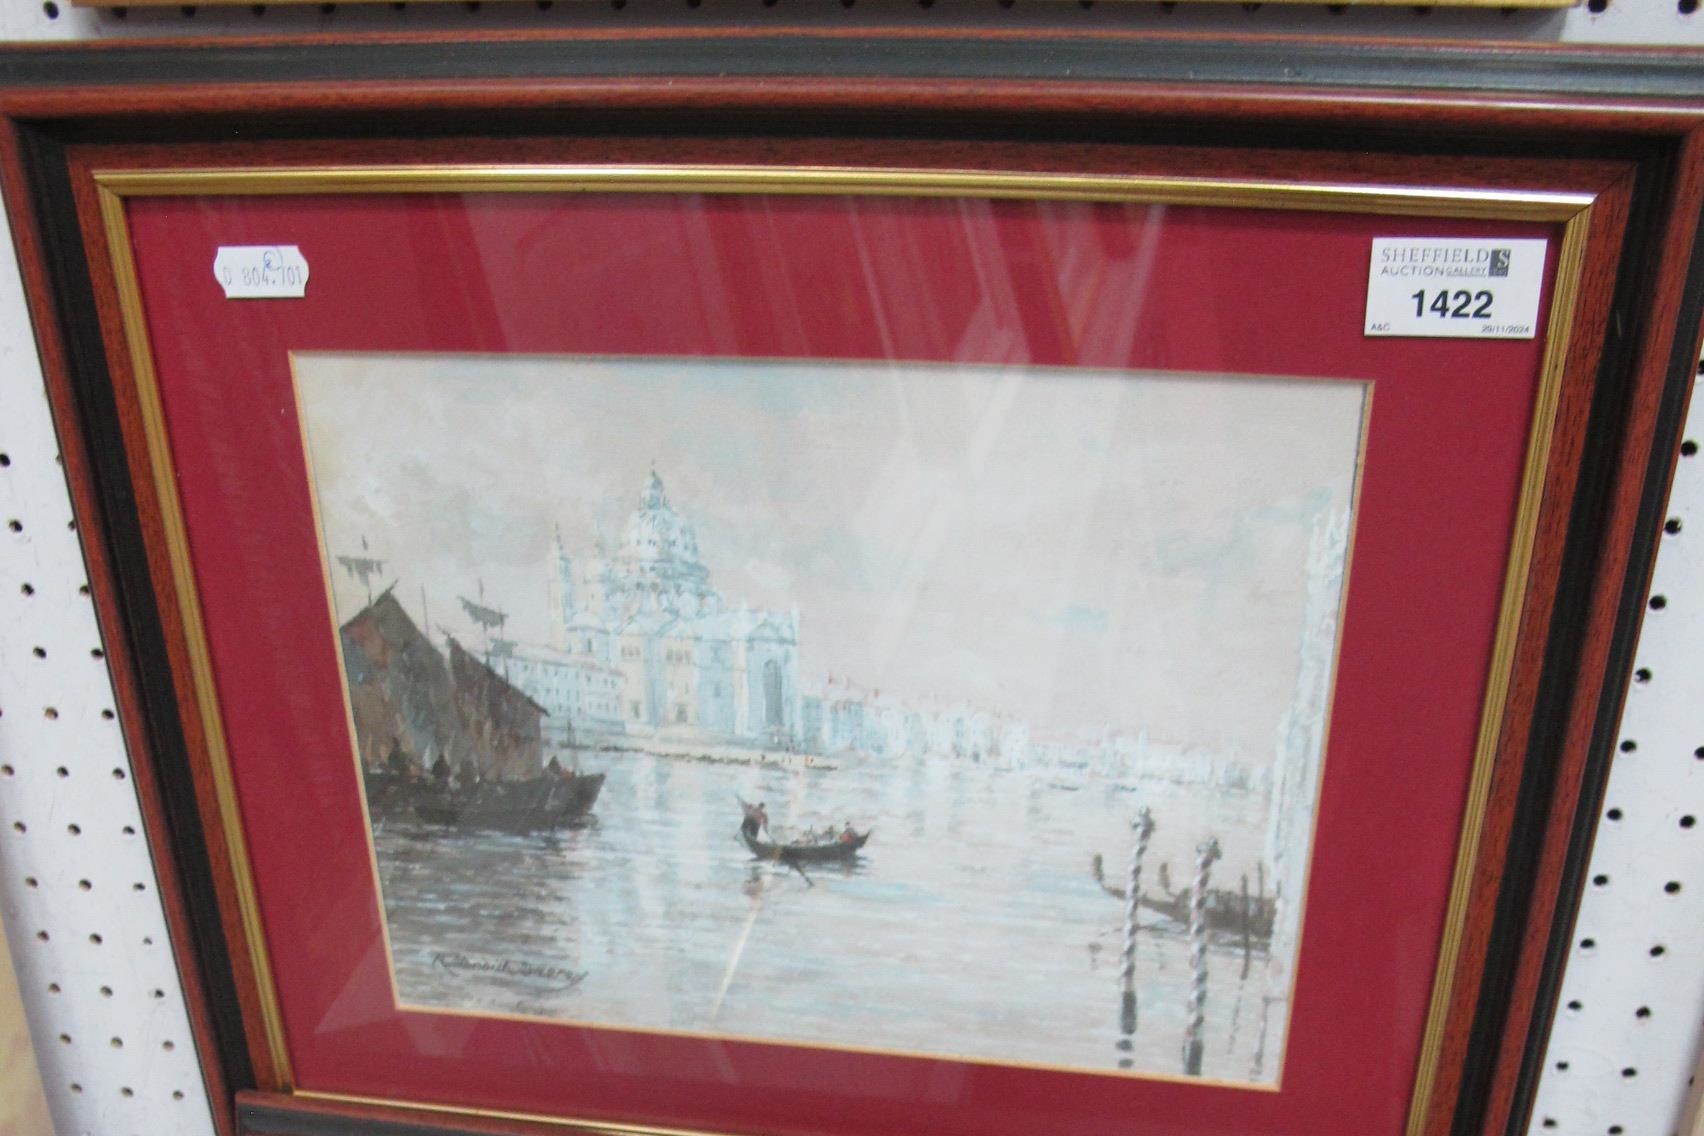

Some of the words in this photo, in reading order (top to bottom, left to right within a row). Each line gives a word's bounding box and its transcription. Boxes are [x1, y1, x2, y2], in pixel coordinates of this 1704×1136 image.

[1381, 247, 1489, 263] SHEFFIELD
[1381, 265, 1444, 277] AUCTION
[1411, 288, 1494, 319] 1422
